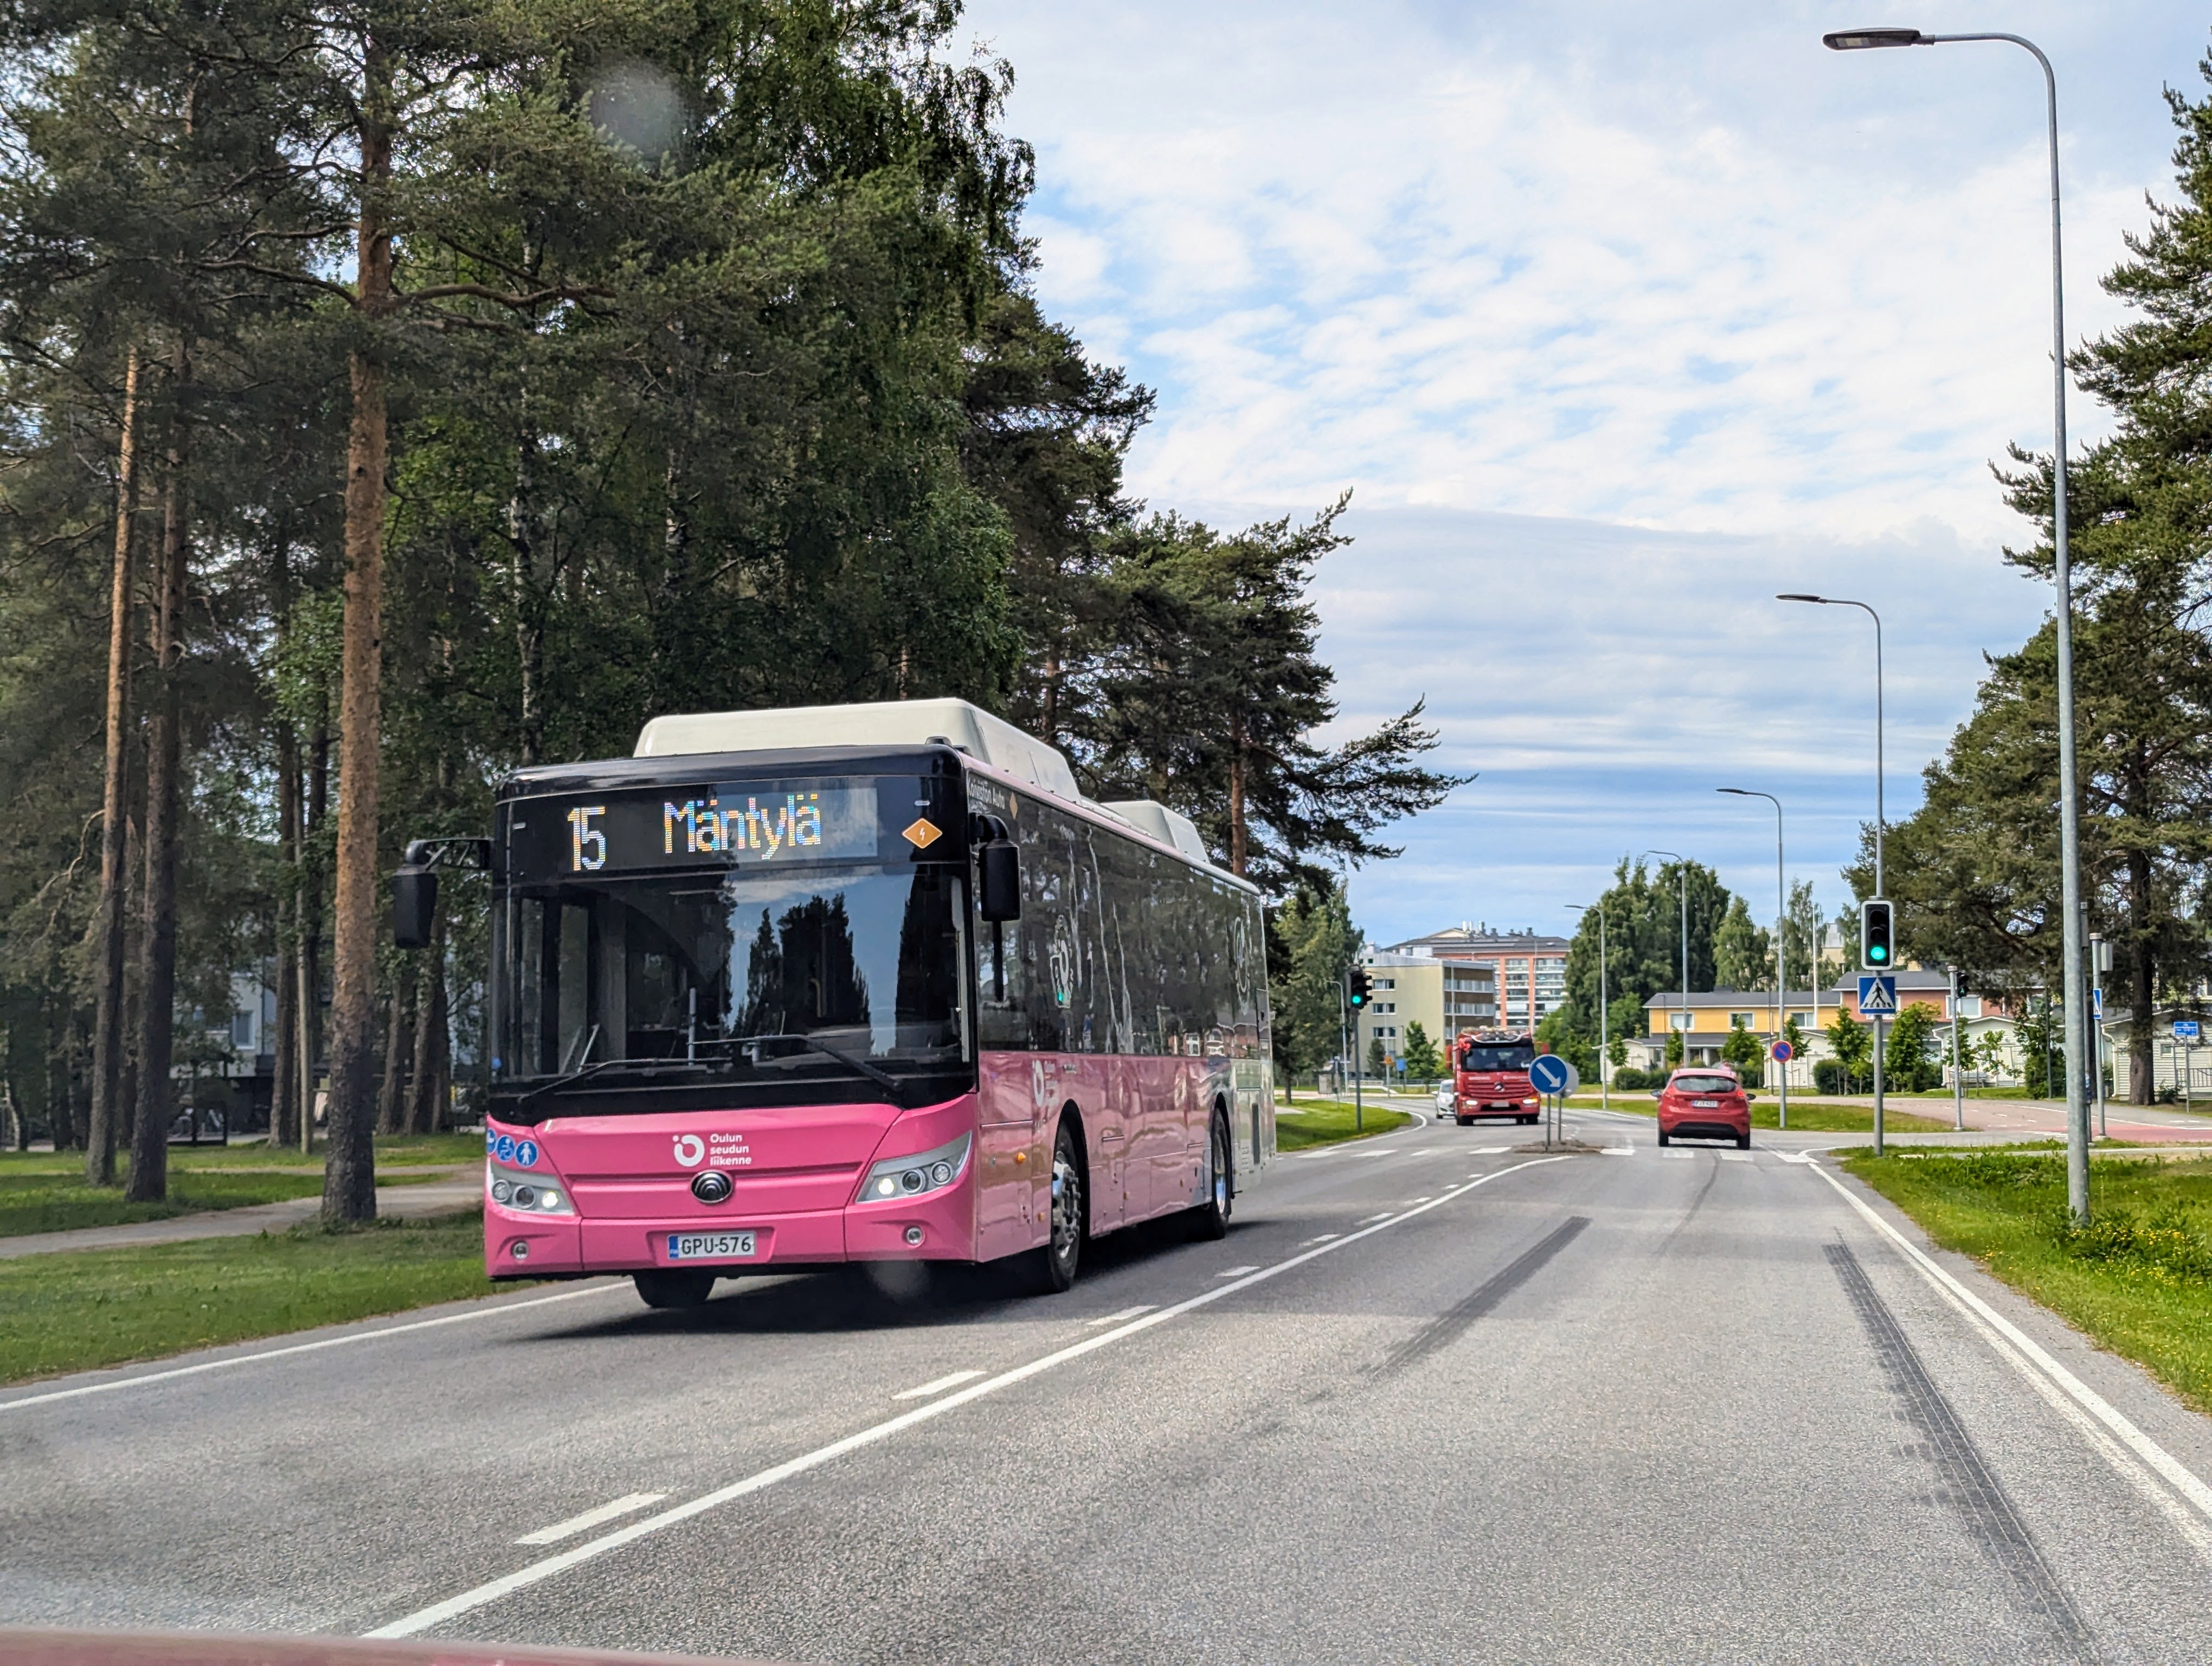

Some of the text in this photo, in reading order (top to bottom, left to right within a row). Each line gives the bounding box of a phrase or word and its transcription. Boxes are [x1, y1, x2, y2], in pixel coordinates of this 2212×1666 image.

[567, 793, 821, 871] 15 Mäntylä
[710, 1133, 742, 1143] Oulun
[710, 1144, 749, 1155] seudun
[710, 1156, 752, 1166] liikenne
[681, 1236, 751, 1255] GPU-576
